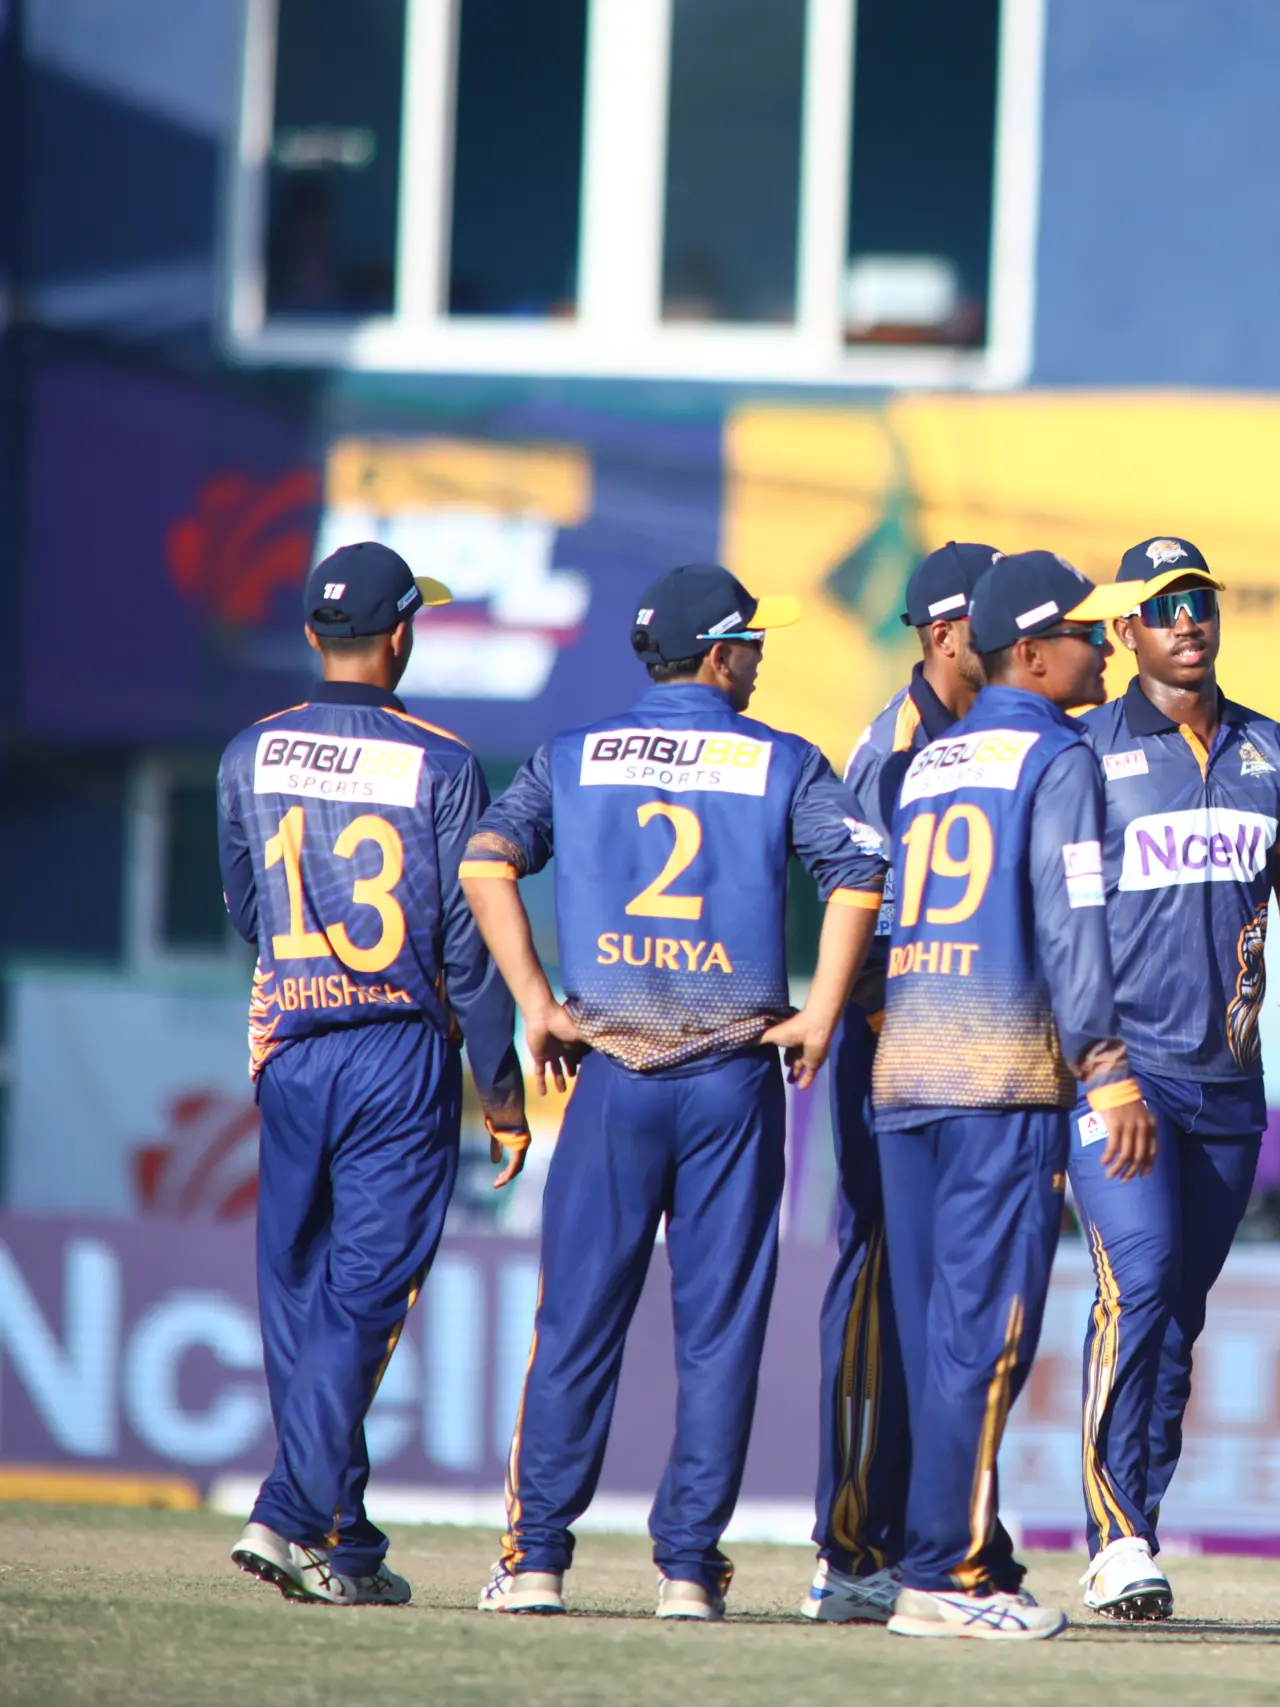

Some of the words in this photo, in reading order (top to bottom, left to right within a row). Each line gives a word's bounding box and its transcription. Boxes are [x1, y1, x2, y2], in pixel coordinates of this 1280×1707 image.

[261, 738, 415, 779] BABU88
[590, 735, 763, 770] BABU88
[287, 774, 374, 797] SPORTS
[624, 765, 722, 785] SPORTS
[625, 801, 703, 920] 2
[899, 803, 994, 927] 19
[1136, 823, 1262, 876] Ncell
[264, 805, 407, 973] 13
[597, 932, 733, 974] SURYA
